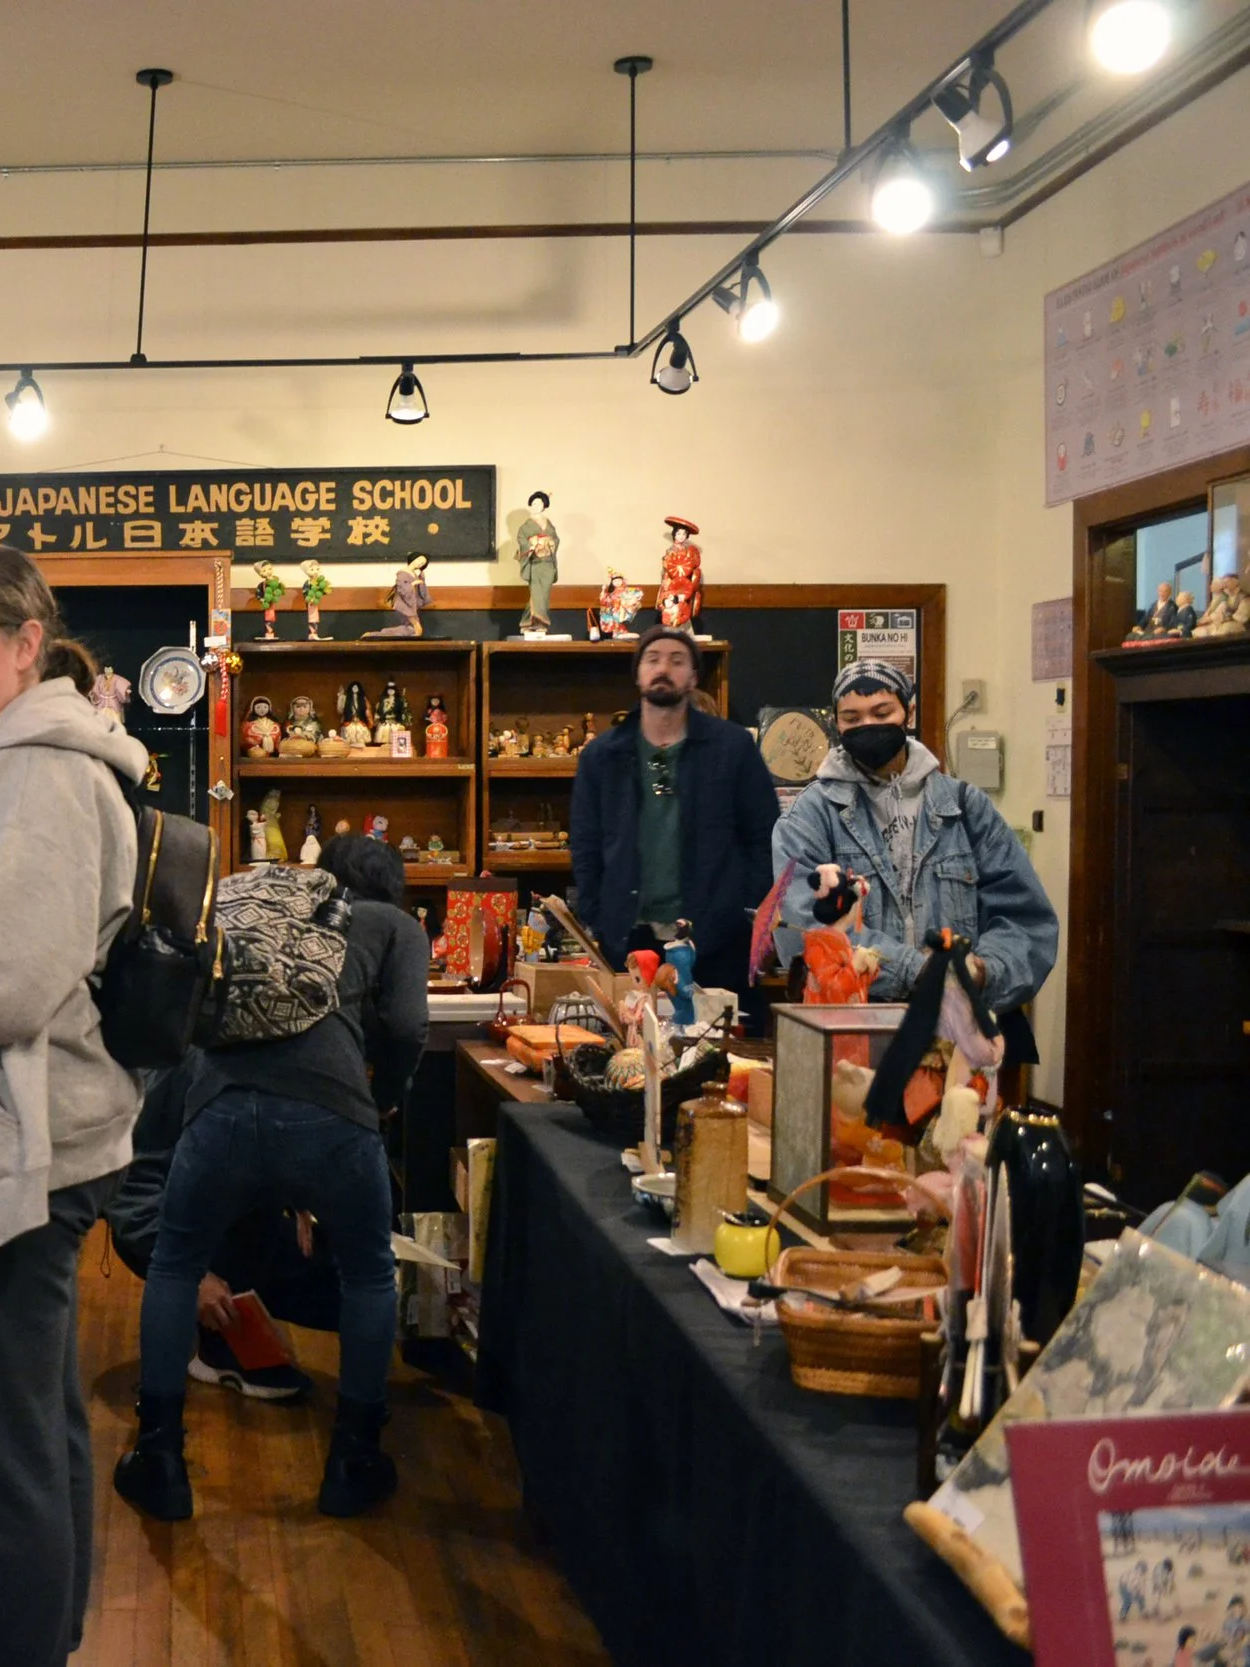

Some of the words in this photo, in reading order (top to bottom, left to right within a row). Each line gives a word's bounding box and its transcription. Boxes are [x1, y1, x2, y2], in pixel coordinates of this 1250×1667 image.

[169, 480, 336, 513] LANGUAGE
[352, 478, 472, 511] SCHOOL
[861, 632, 886, 643] BUNKA
[888, 632, 900, 643] NO
[900, 633, 908, 642] HI
